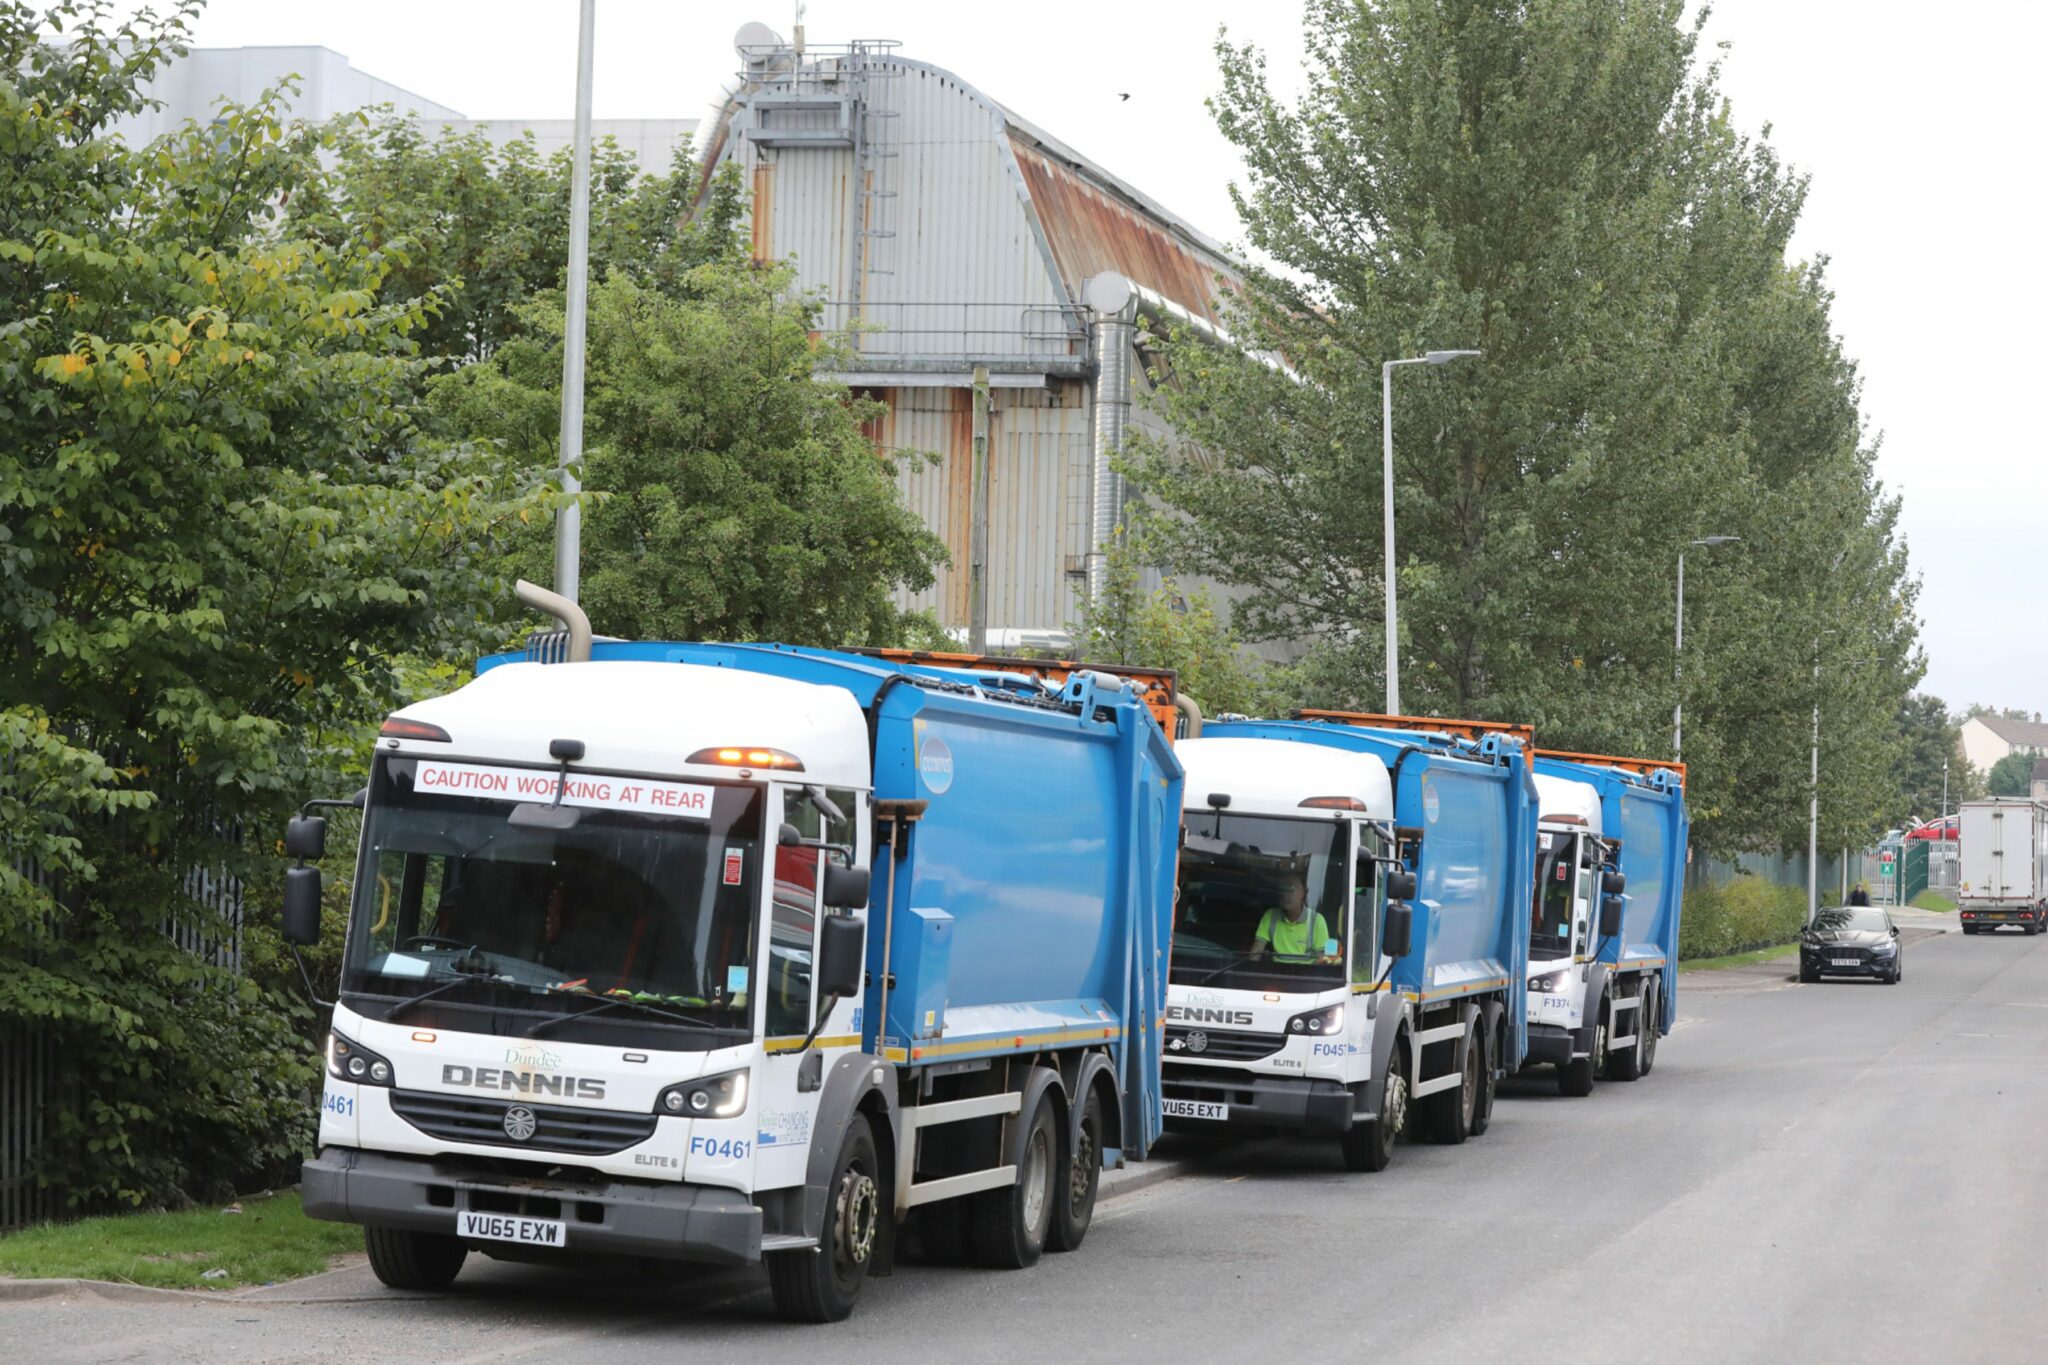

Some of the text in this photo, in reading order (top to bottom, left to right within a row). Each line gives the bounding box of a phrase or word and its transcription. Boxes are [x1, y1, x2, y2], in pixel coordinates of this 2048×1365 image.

[422, 768, 508, 792] CAUTION
[619, 786, 643, 803] AT
[651, 789, 705, 809] REAR
[1166, 1006, 1253, 1025] ENNIS
[505, 1048, 562, 1068] Dundee
[1273, 1058, 1296, 1067] ELITE
[442, 1064, 606, 1100] DENNIS
[322, 1091, 353, 1117] 0461
[1162, 1101, 1223, 1118] VU65 EXT
[691, 1136, 751, 1159] F0461
[634, 1154, 677, 1168] ELITE 6
[467, 1215, 557, 1243] VU65 EXW
